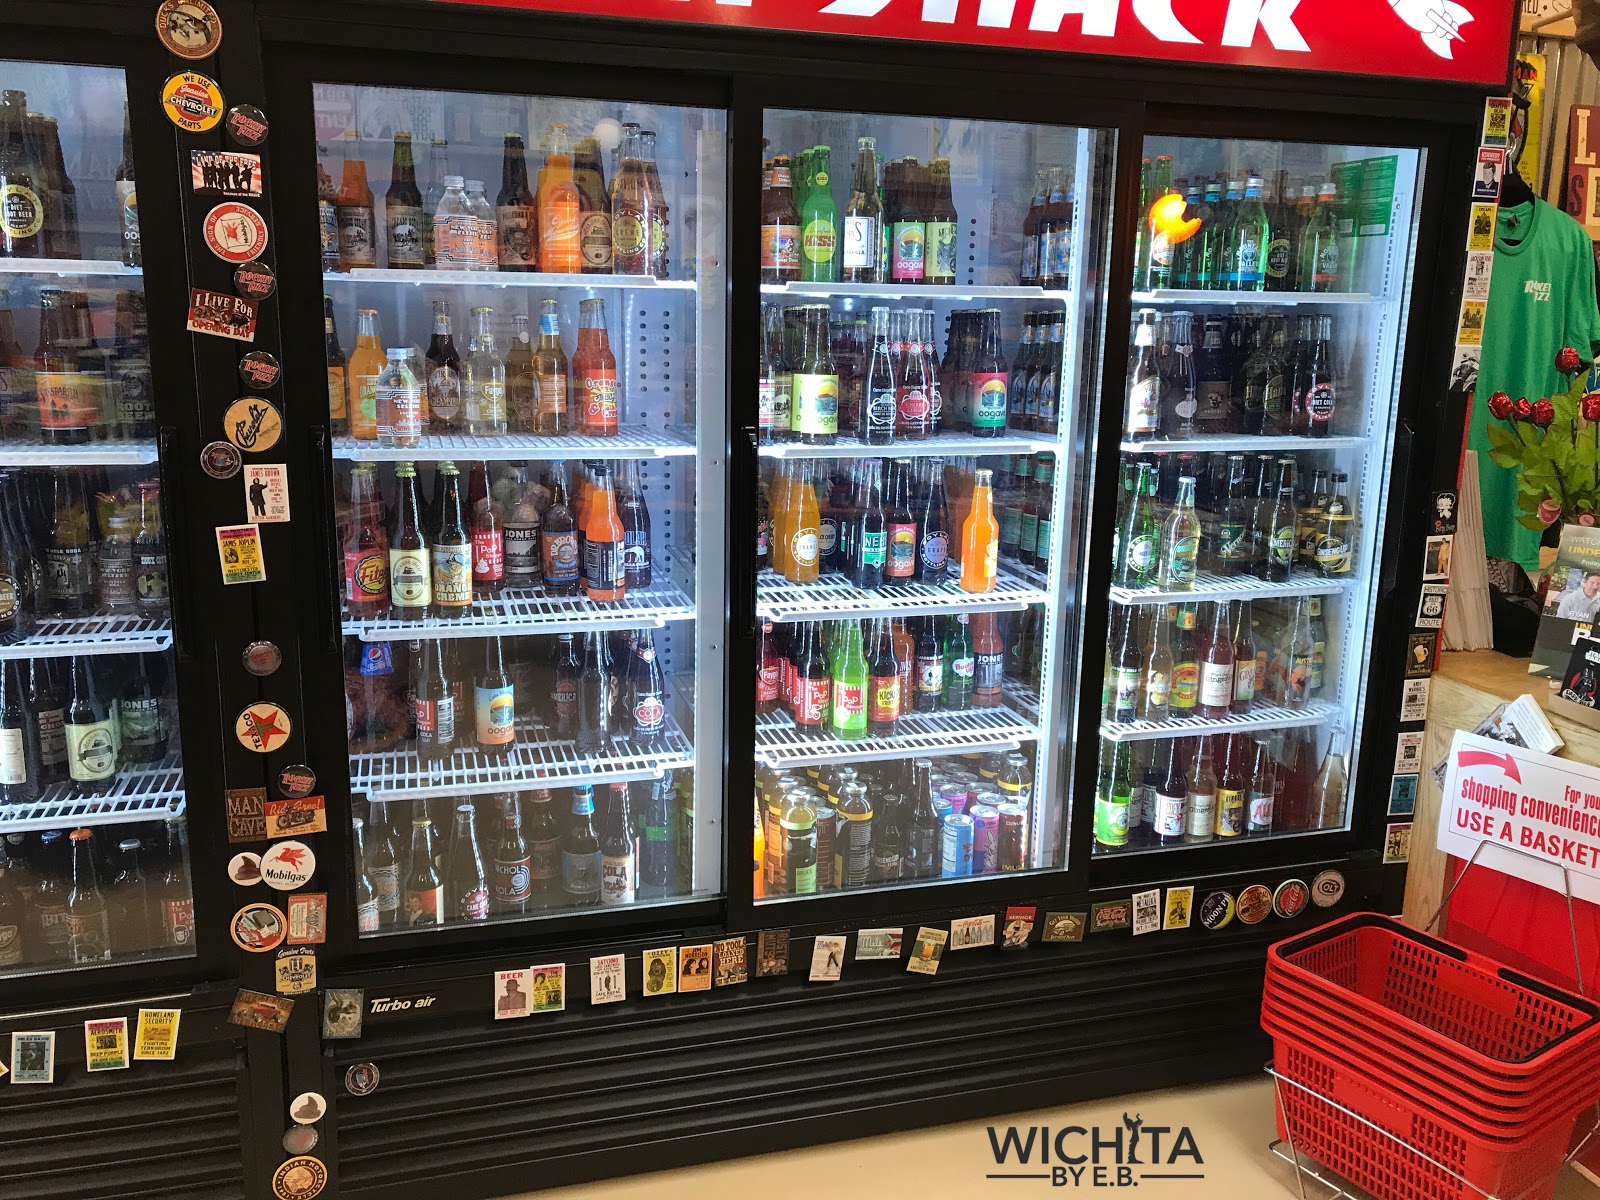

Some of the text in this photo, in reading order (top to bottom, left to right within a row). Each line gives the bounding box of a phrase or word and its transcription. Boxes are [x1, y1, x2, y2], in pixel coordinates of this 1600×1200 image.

[160, 2, 175, 29] DUCKS
[818, 0, 1312, 52] ACK
[182, 75, 212, 91] WE USE
[169, 96, 219, 116] CHEVROLET
[177, 117, 202, 130] PARTS
[1574, 108, 1597, 166] L
[195, 155, 258, 171] LAND OF THE FREE
[18, 210, 33, 218] BEER
[210, 214, 218, 223] OF
[207, 227, 215, 242] SIGN
[615, 229, 641, 237] CREME
[804, 235, 836, 247] KISS
[195, 293, 202, 307] I
[192, 320, 251, 338] OPENING DAY
[484, 385, 503, 396] Fargo
[117, 401, 152, 411] ROOT
[588, 403, 600, 415] &
[250, 470, 264, 478] JAMES
[264, 469, 281, 478] BROWN
[505, 529, 537, 539] JONES
[222, 538, 257, 548] JANIS JOPLIN
[434, 583, 472, 593] ORANGE
[436, 591, 471, 602] CREME
[1426, 605, 1438, 614] 66
[1569, 610, 1590, 619] RYAN
[1419, 619, 1440, 627] ROUTE
[121, 698, 157, 709] JONES
[843, 696, 859, 705] PoP
[638, 709, 661, 718] COLA
[242, 713, 262, 750] TEXACO
[487, 725, 514, 739] oogav
[1461, 776, 1518, 817] shopping
[1564, 785, 1582, 804] For
[227, 796, 265, 817] MAN
[228, 817, 267, 838] CAVE
[1456, 807, 1600, 869] USE A BASKET
[265, 869, 307, 883] Mobilgas
[603, 864, 628, 881] COLA
[1204, 907, 1224, 927] MOON
[714, 939, 747, 954] NO TOOLS
[719, 949, 744, 959] LOANED
[719, 956, 744, 966] HERE
[500, 972, 524, 980] BEER
[370, 995, 437, 1014] Turbo air
[144, 1011, 175, 1019] HOMELAND
[279, 1160, 306, 1180] INDIAN
